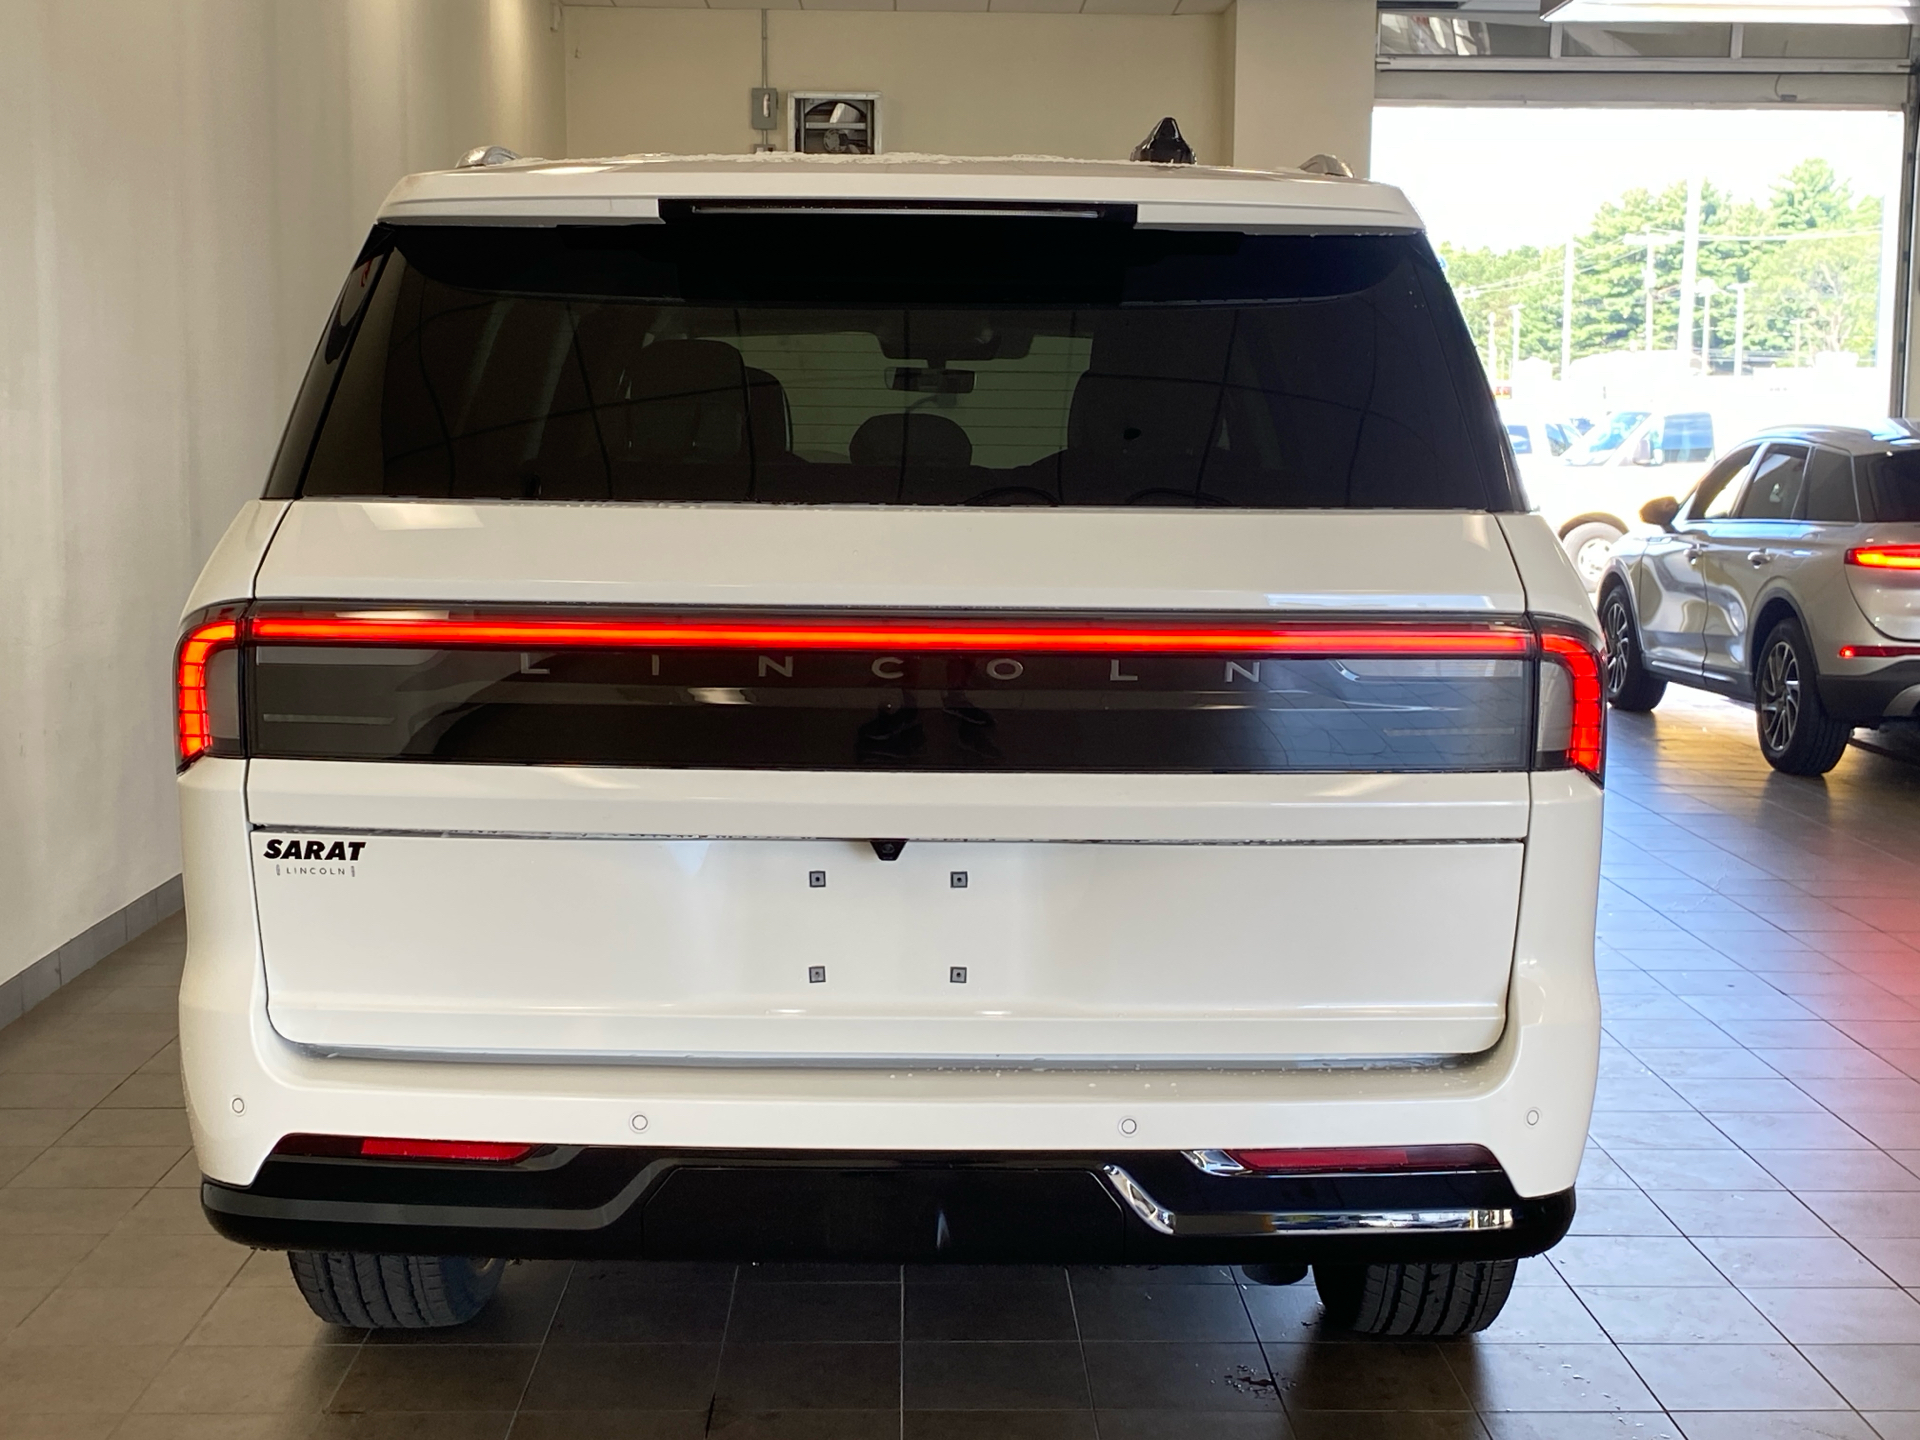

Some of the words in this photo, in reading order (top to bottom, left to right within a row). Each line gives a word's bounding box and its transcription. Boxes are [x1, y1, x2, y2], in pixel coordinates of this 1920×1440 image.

[520, 652, 1260, 683] LINCOLN
[263, 839, 366, 861] SARAT
[286, 867, 345, 875] LINCOLN
